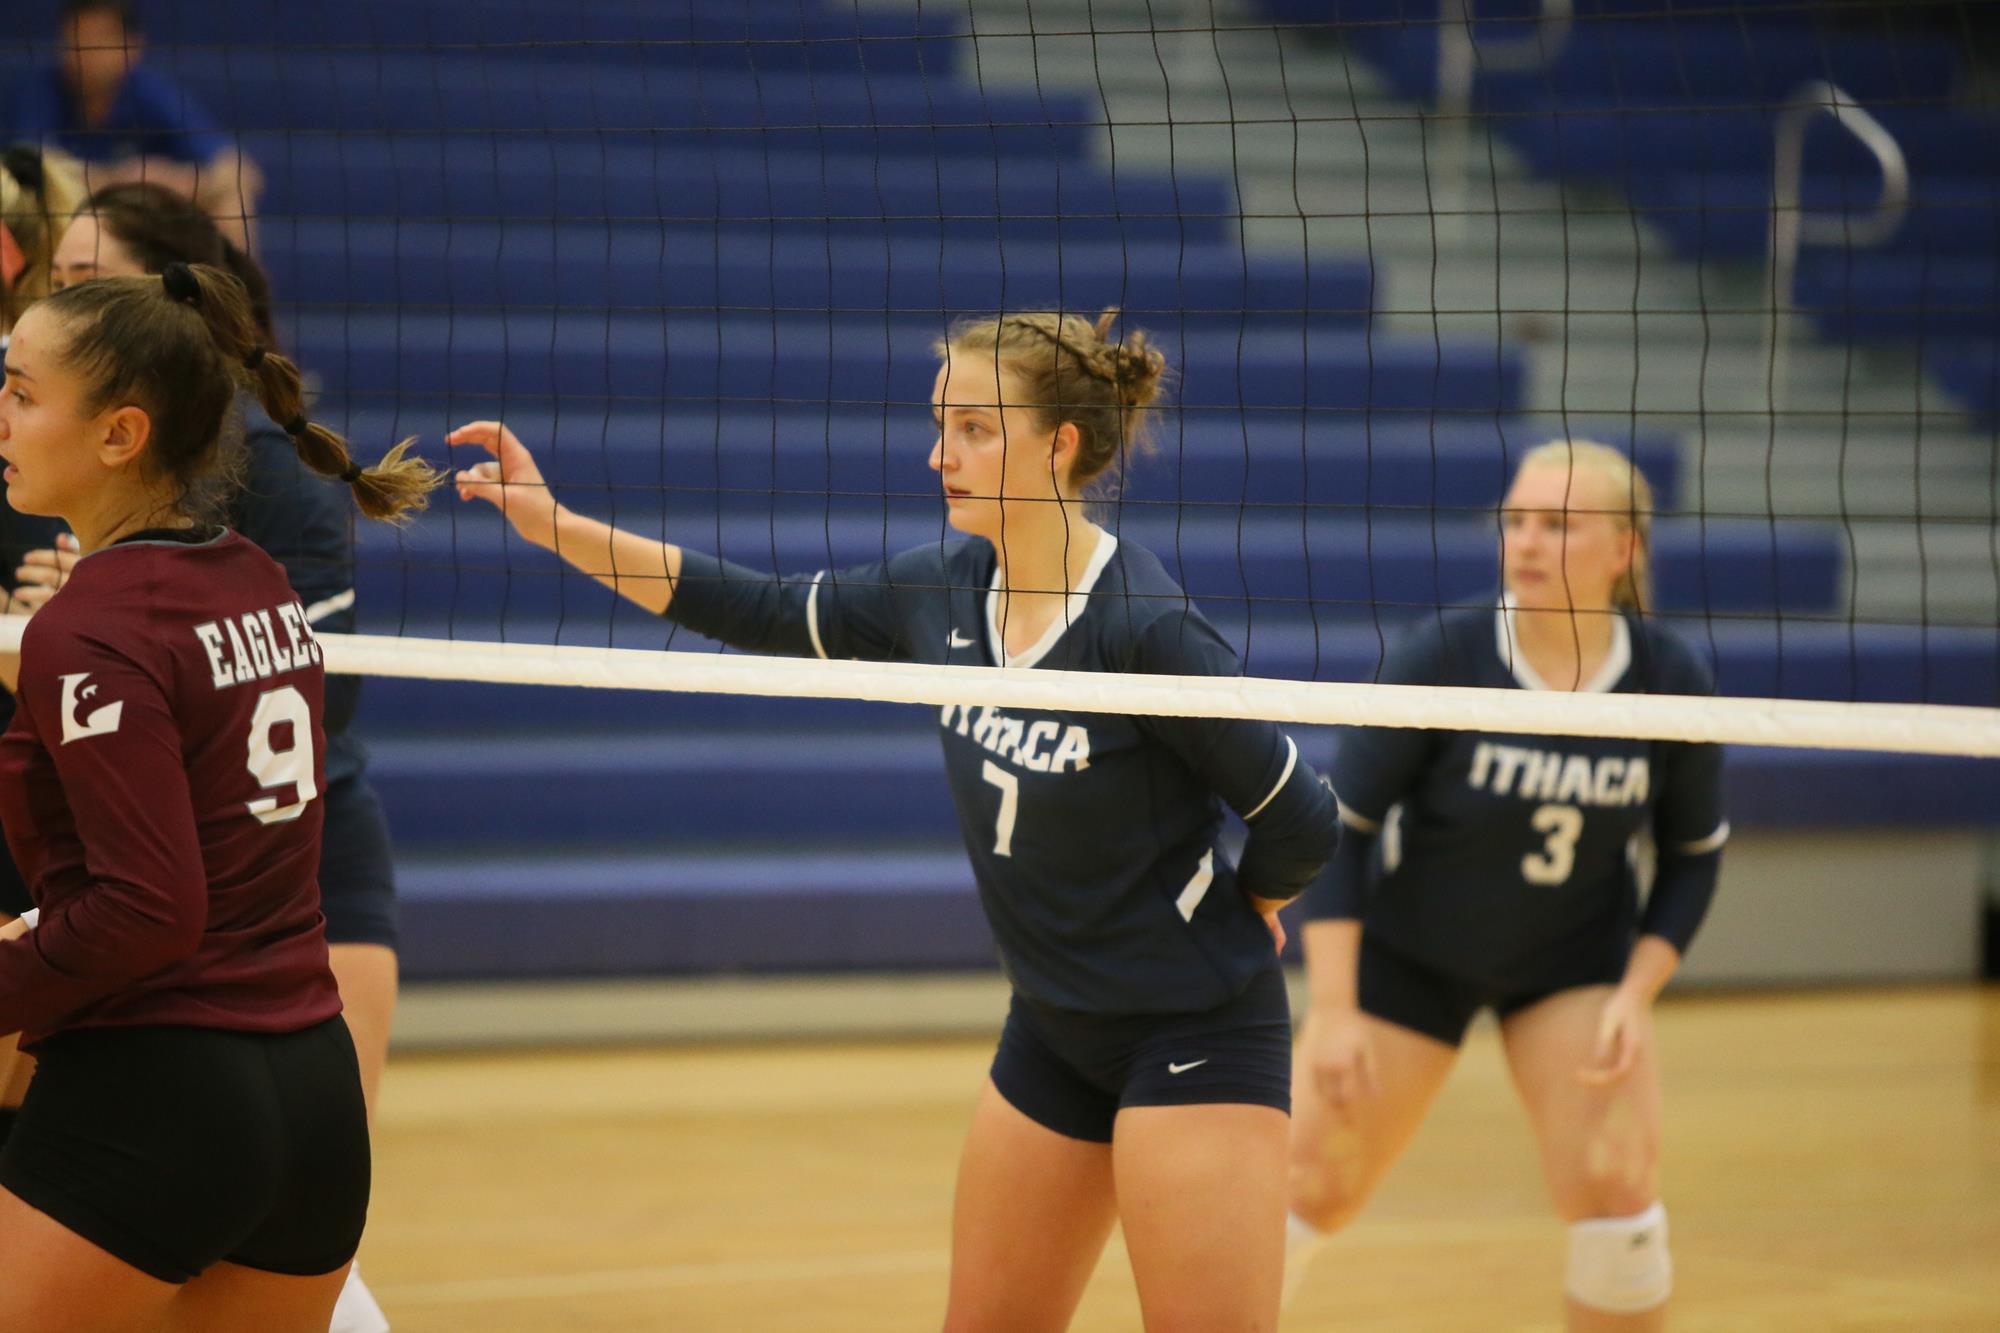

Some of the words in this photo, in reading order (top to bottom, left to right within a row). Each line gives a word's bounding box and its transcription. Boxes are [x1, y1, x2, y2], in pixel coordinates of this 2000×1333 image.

[245, 684, 317, 825] 9
[1468, 742, 1650, 806] ITHACA
[982, 759, 1019, 857] 7
[1520, 803, 1584, 886] 3
